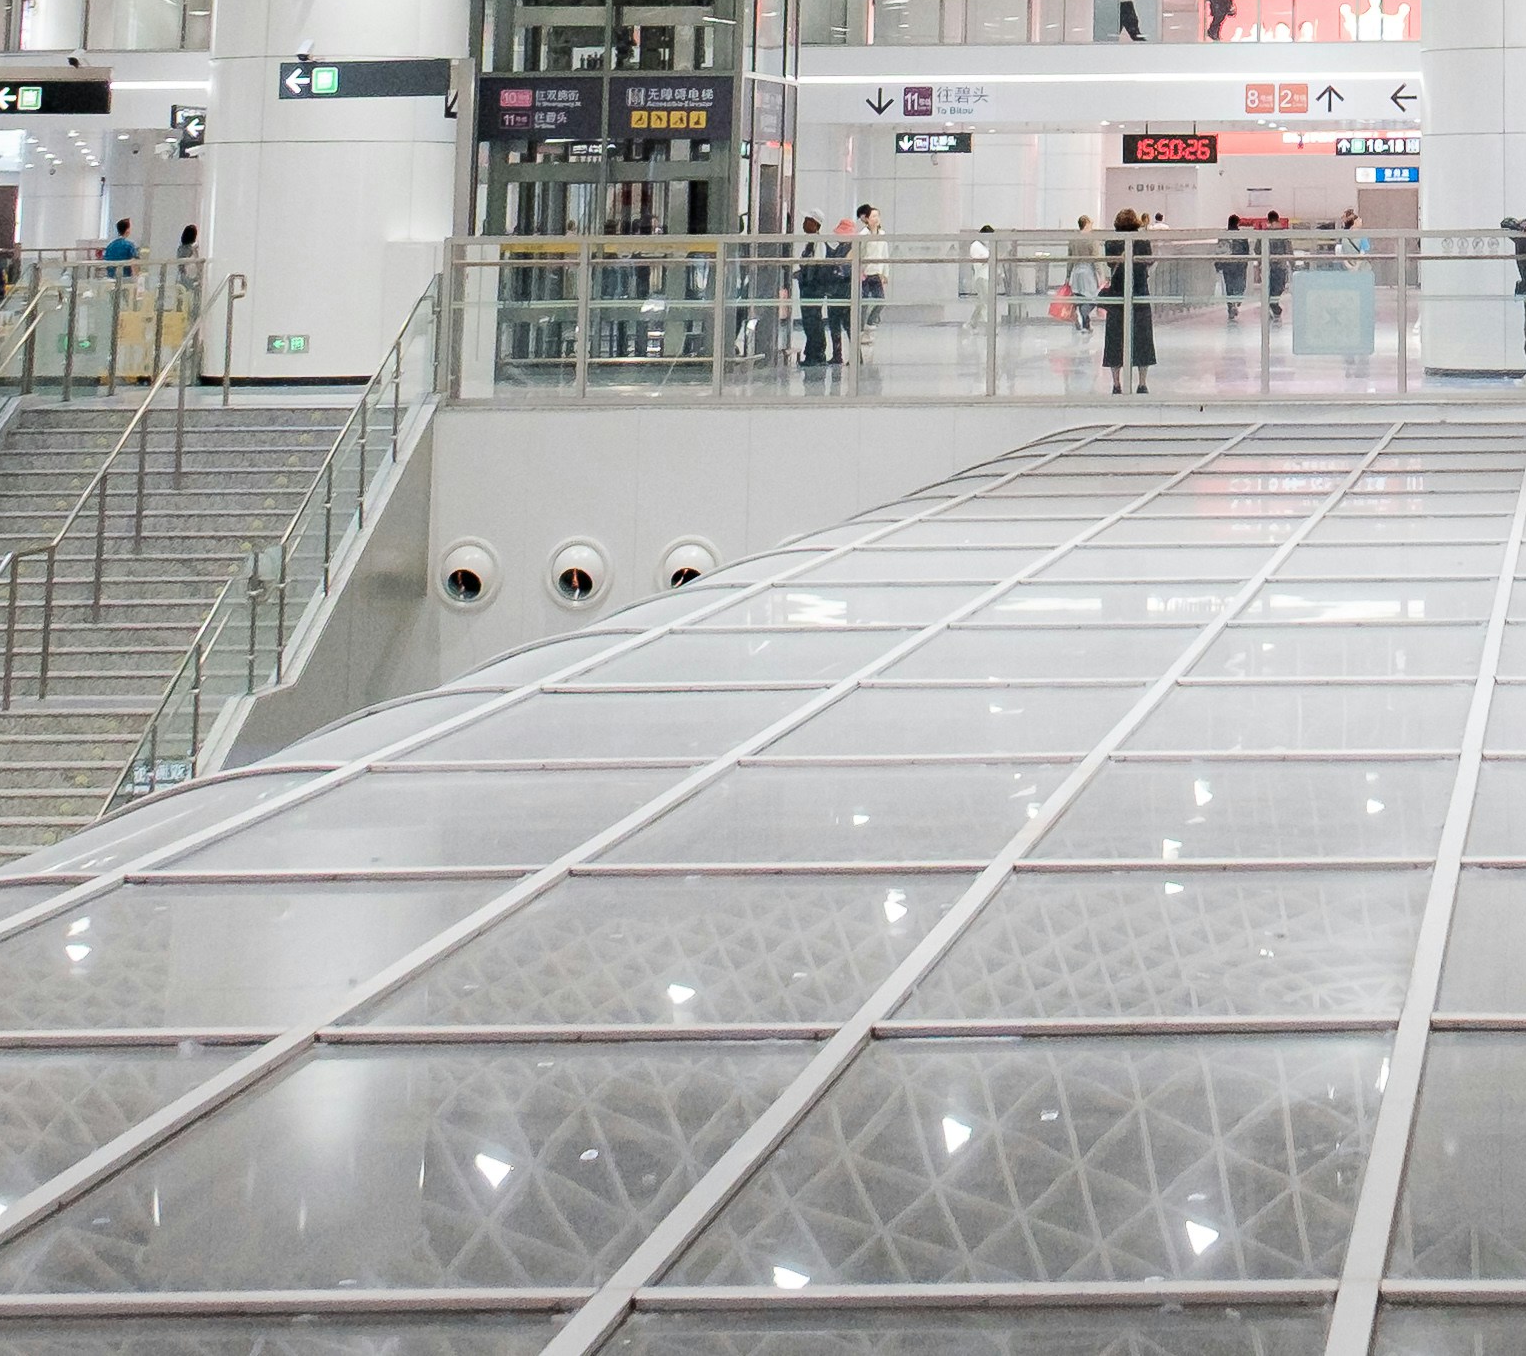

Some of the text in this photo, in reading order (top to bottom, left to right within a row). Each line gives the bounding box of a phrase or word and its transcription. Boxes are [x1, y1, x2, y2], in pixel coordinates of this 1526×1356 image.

[647, 88, 713, 100] 无障碍电梯
[905, 93, 919, 111] 11
[937, 86, 989, 104] 往碧头
[1247, 89, 1259, 108] 8
[1280, 89, 1292, 108] 2
[503, 114, 515, 125] 11
[937, 106, 973, 115] To Bitou
[1136, 138, 1210, 160] 15:50:26
